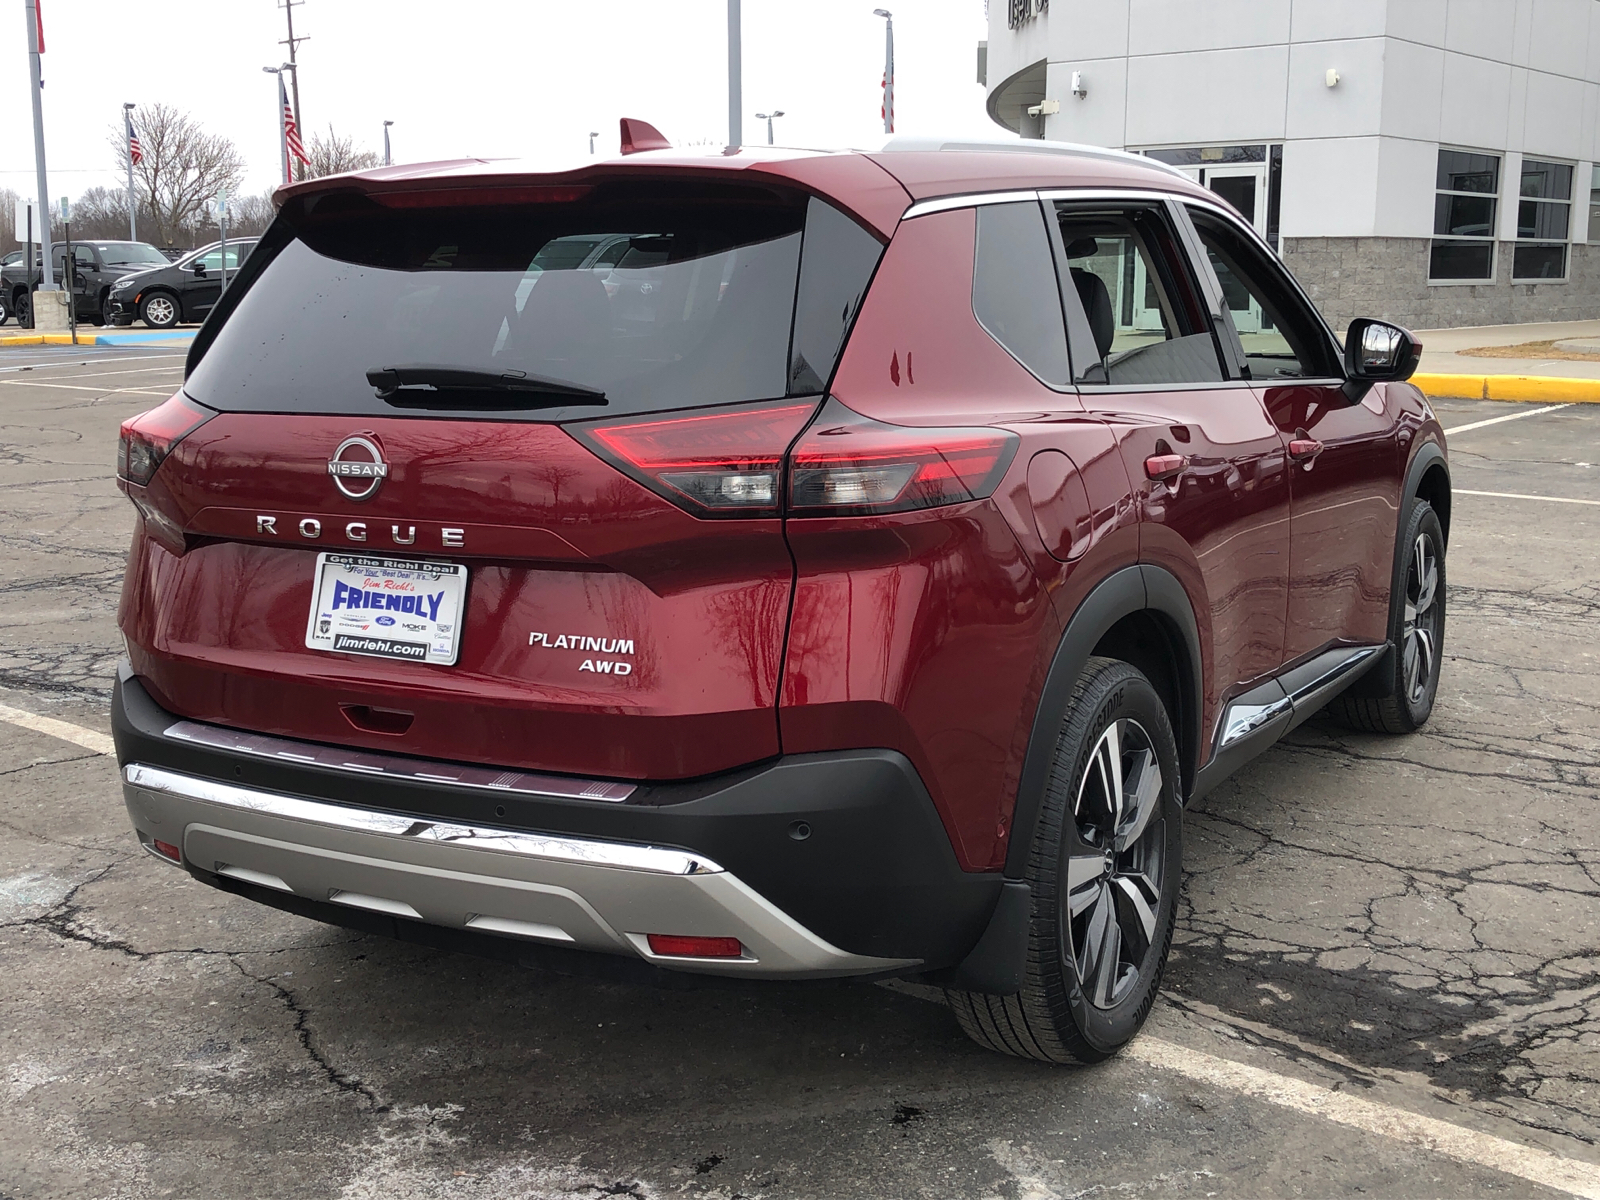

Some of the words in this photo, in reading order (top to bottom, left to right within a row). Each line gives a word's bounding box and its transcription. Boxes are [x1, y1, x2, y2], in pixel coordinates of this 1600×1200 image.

[328, 463, 386, 476] NISSAN
[256, 515, 466, 548] ROGUE
[330, 556, 354, 565] Get
[357, 557, 380, 567] the
[383, 560, 419, 570] Riehl
[423, 564, 454, 573] Deal
[353, 566, 364, 574] For
[364, 567, 379, 577] Your
[362, 578, 381, 590] Jim
[383, 579, 415, 592] Riehl's
[332, 579, 445, 622] FRIENDLY
[401, 623, 427, 631] MOKE
[336, 635, 426, 657] jimriehl.com
[528, 631, 635, 655] PLATINUM
[578, 659, 632, 676] AWD
